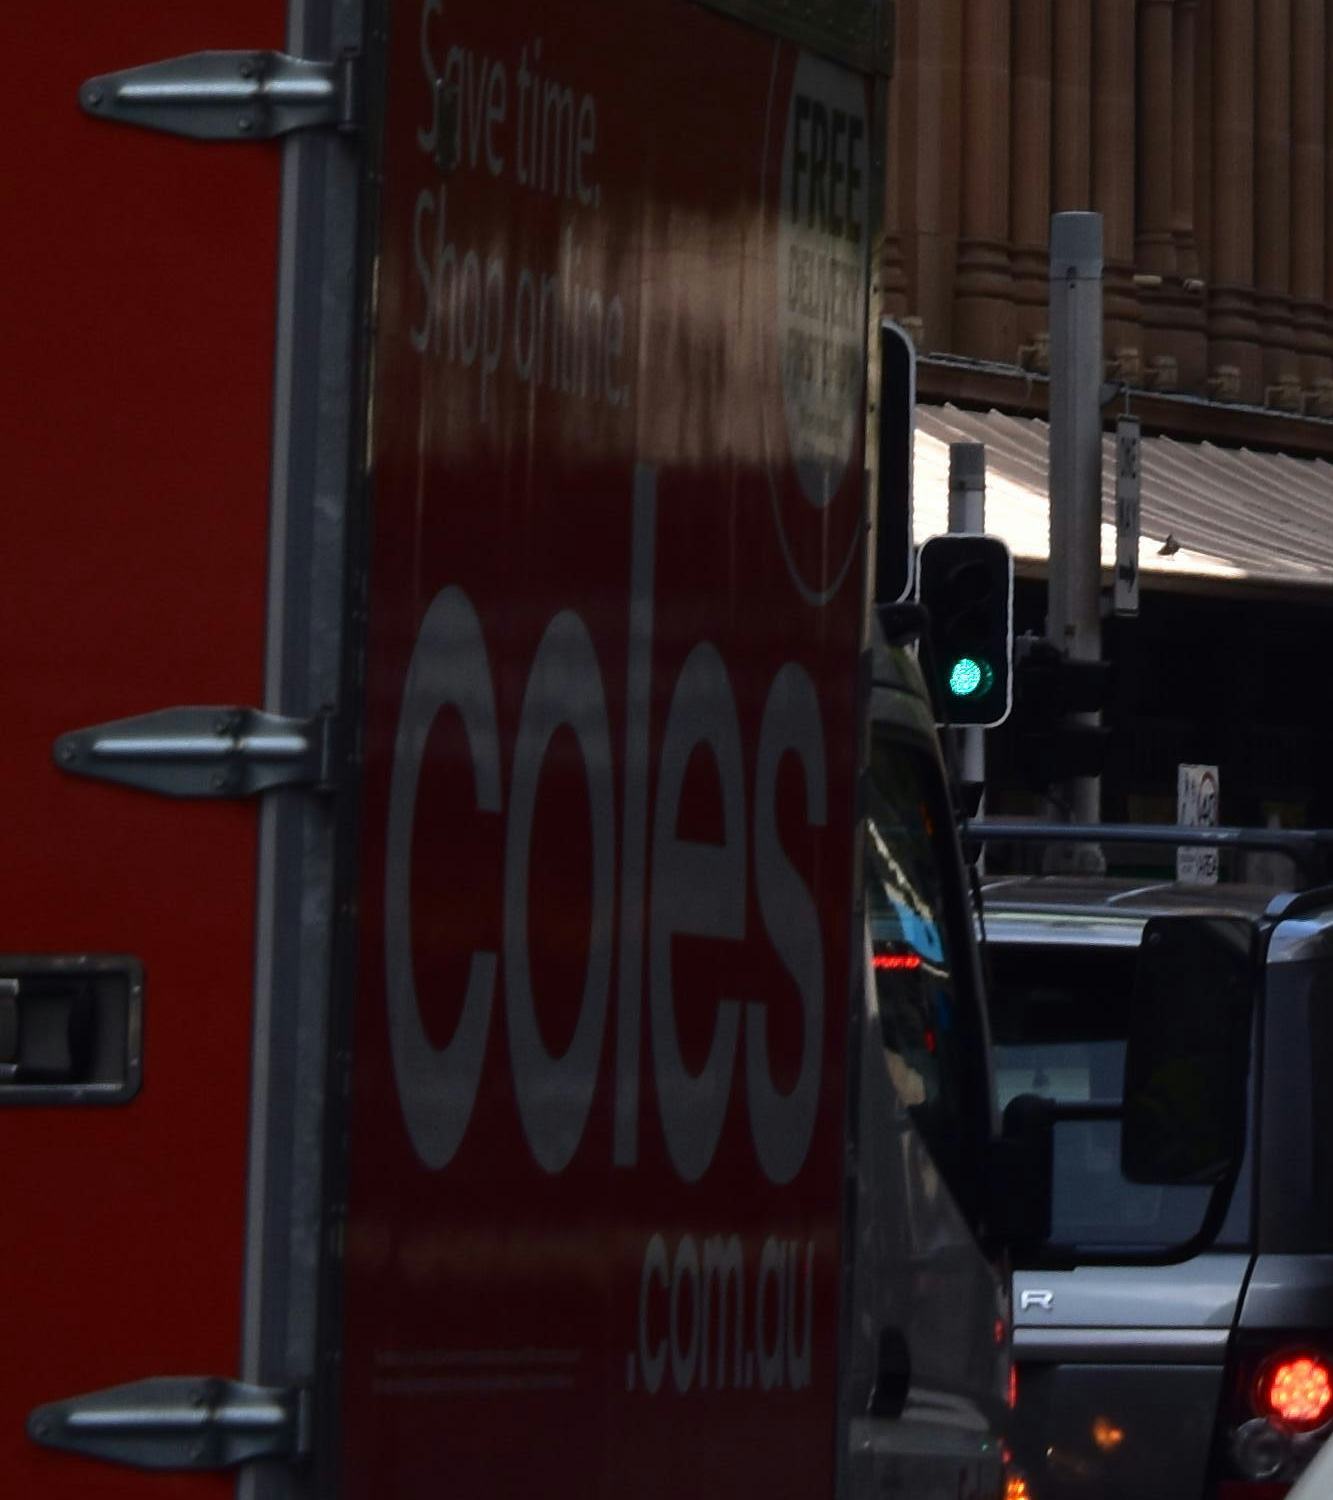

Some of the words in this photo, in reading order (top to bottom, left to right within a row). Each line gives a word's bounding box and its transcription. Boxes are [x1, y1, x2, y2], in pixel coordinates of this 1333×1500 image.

[515, 35, 602, 210] time.
[791, 94, 865, 244] FREE
[409, 181, 506, 424] Shop
[512, 225, 632, 411] online.
[385, 462, 828, 1186] coles
[627, 1232, 815, 1394] .com.au
